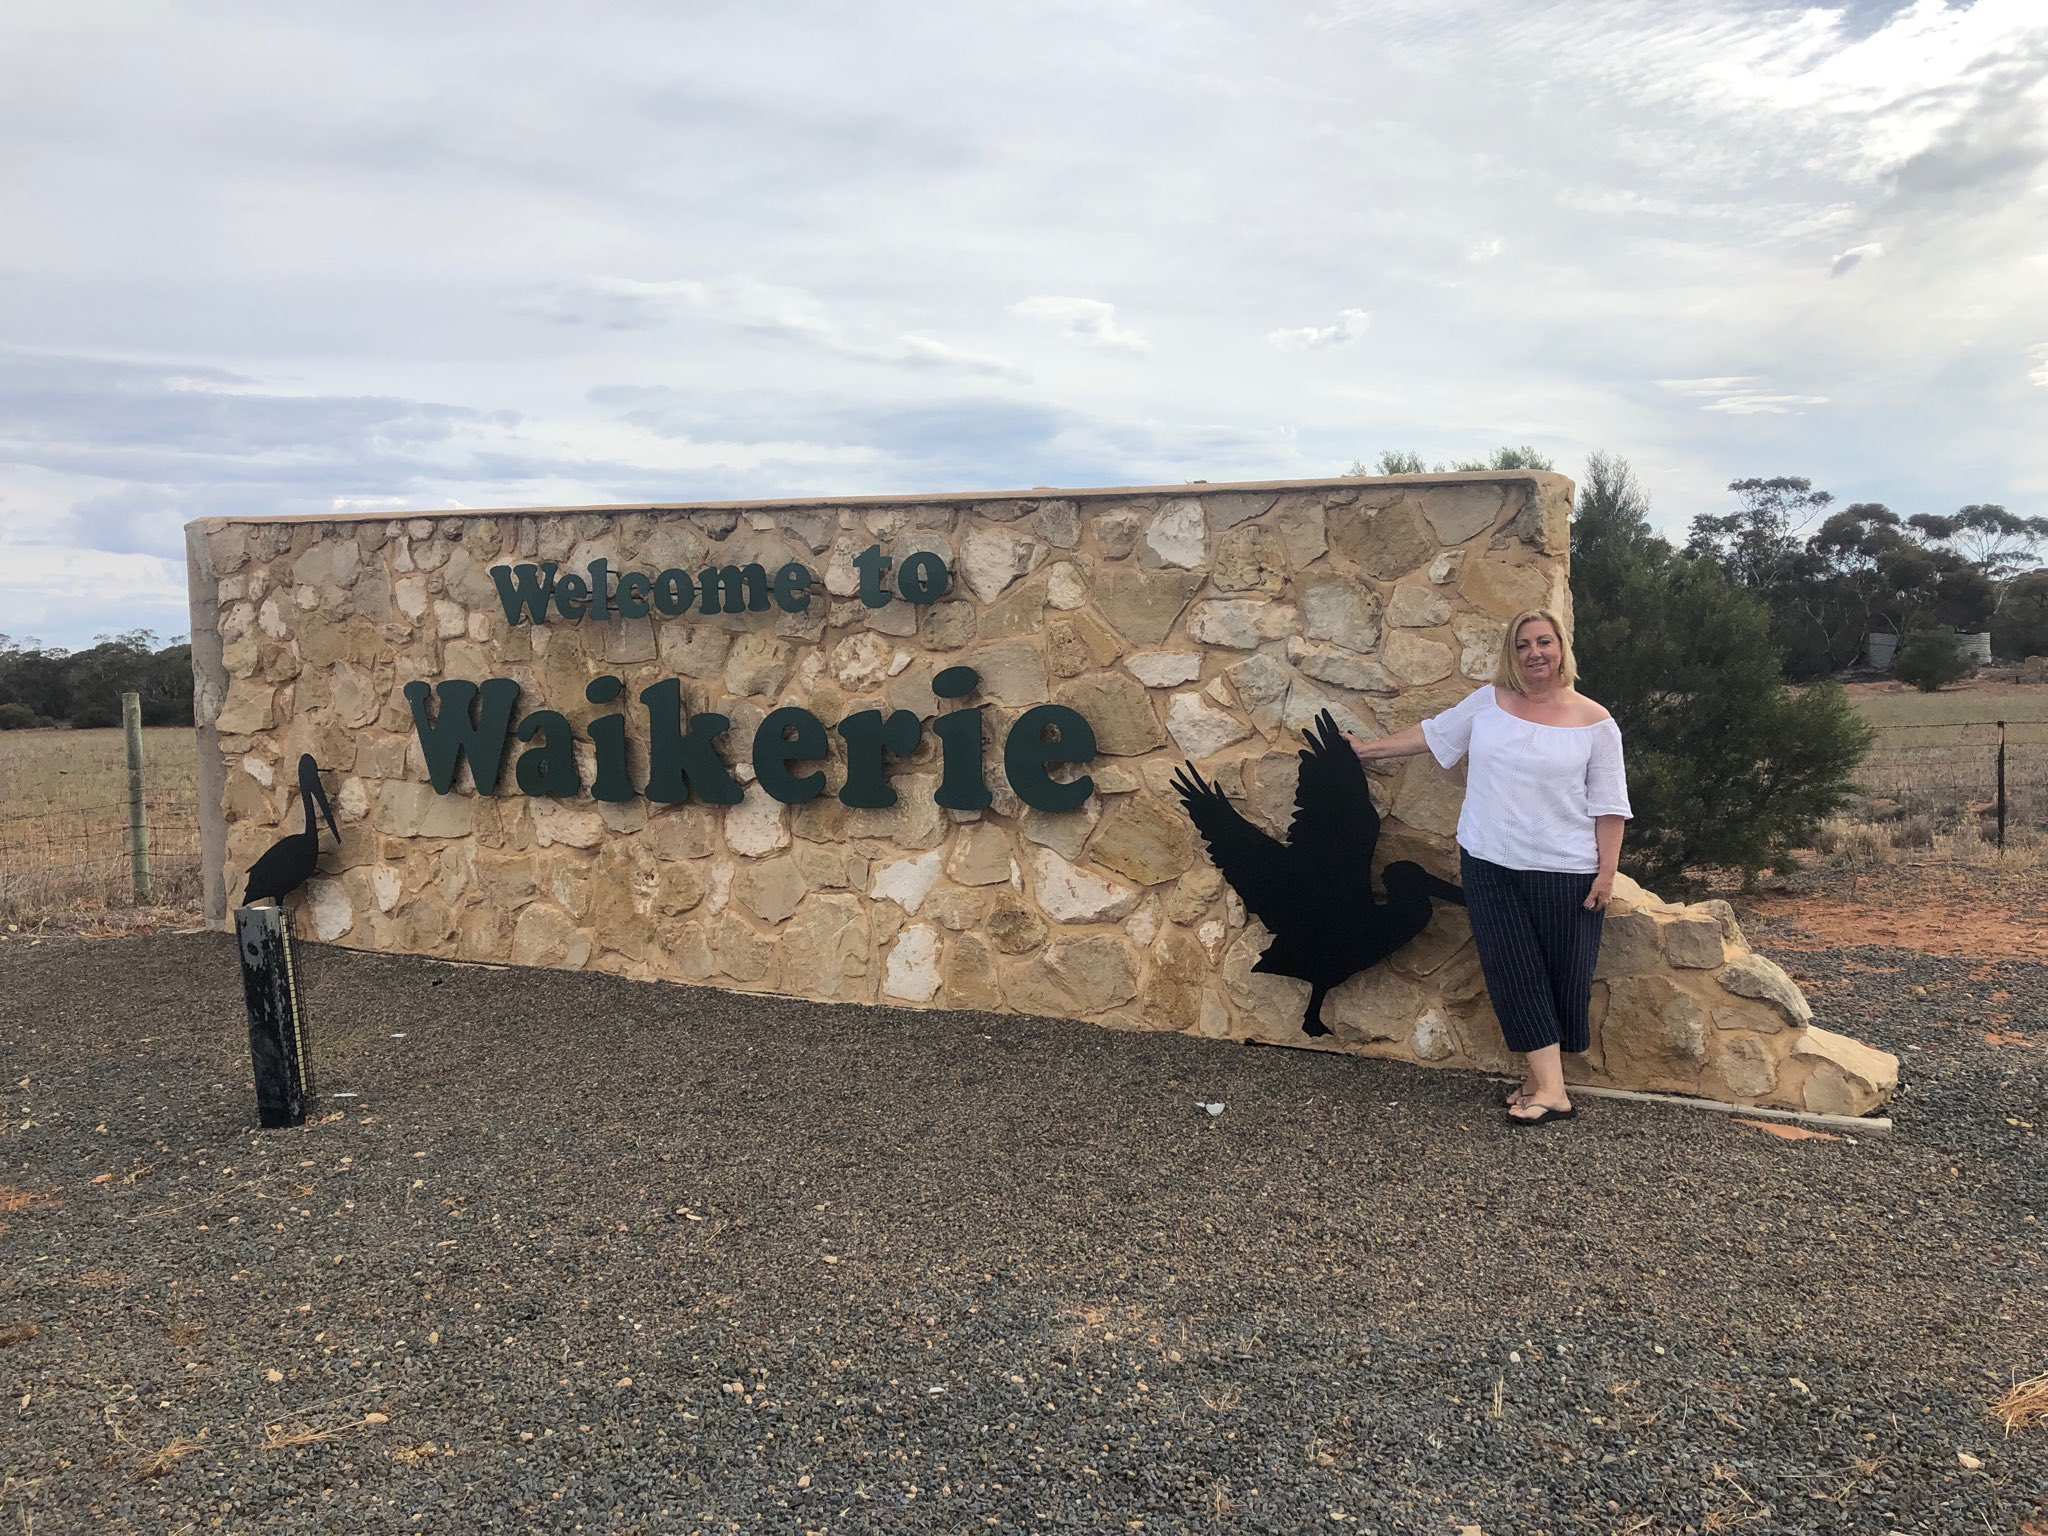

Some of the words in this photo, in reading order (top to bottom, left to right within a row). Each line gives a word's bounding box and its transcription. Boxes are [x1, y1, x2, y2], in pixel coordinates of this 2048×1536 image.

[490, 558, 811, 626] Welcome
[853, 544, 949, 608] to
[404, 666, 1098, 812] Waikerie
